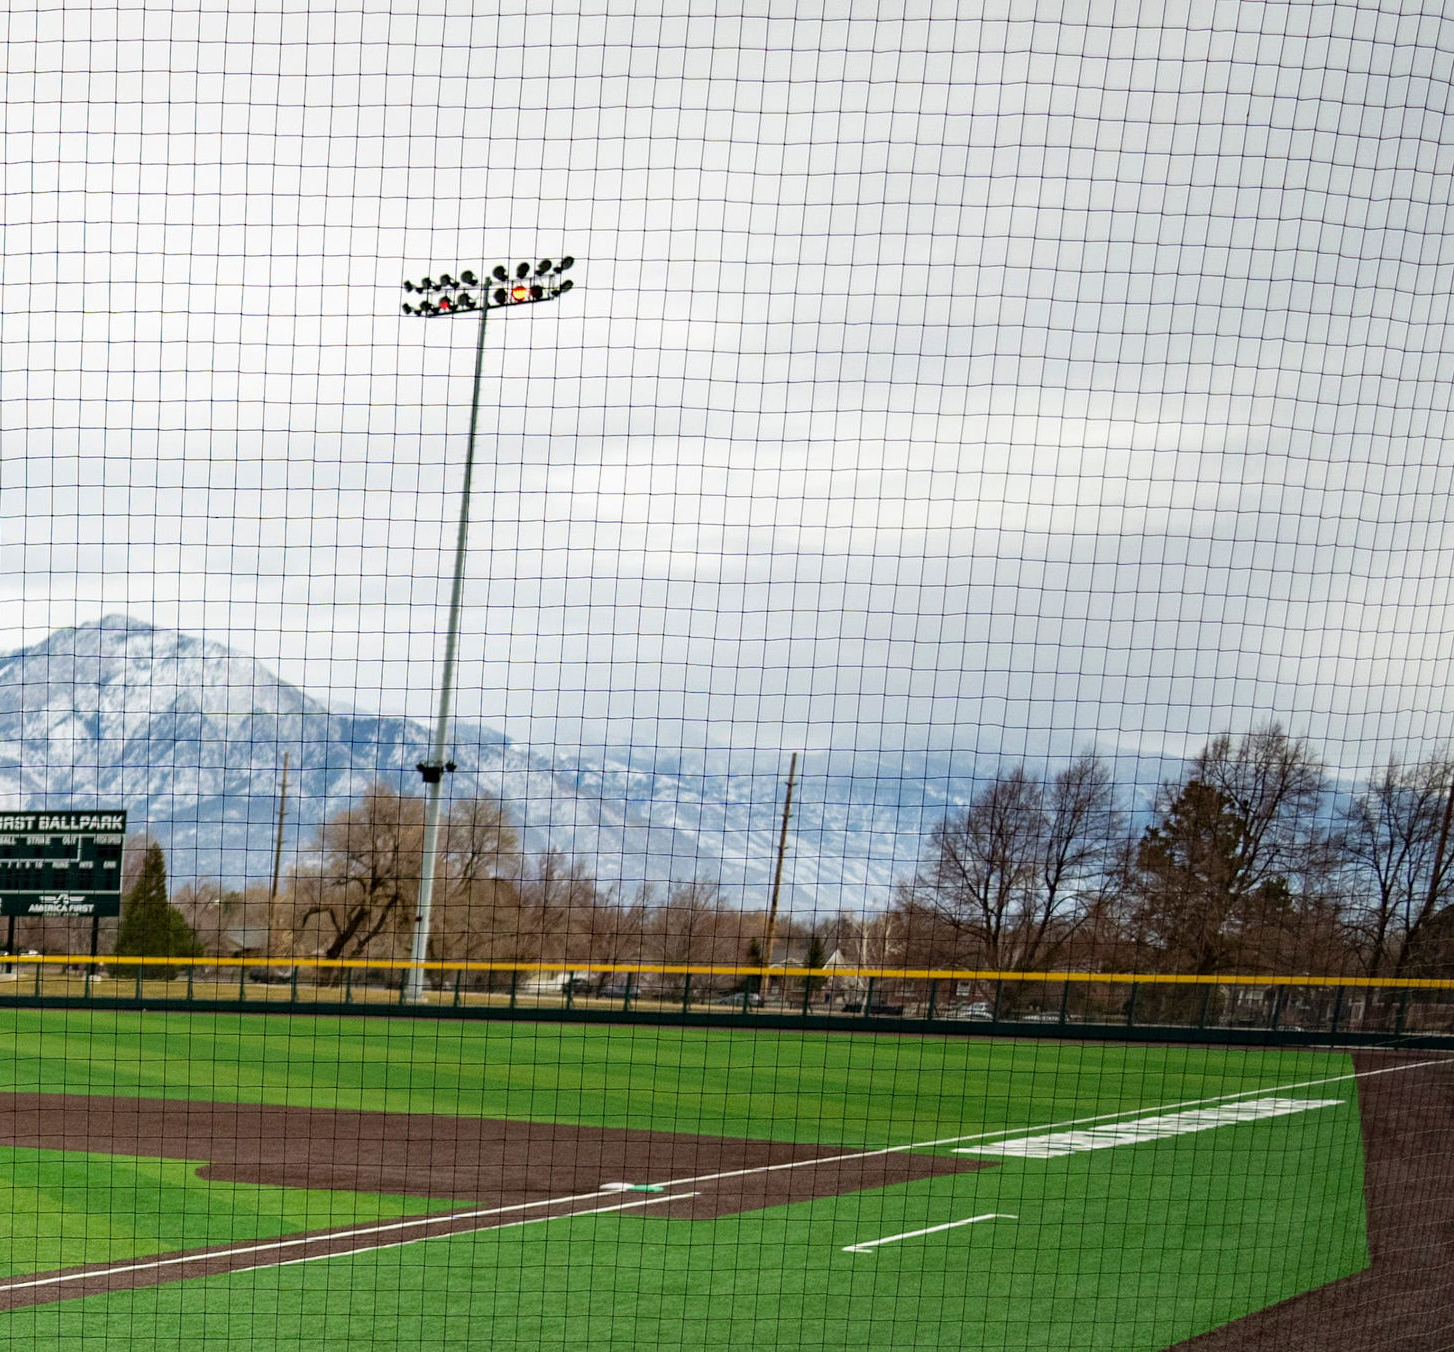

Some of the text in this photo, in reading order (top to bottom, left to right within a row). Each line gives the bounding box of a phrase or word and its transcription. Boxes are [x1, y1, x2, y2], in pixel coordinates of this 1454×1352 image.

[38, 815, 123, 830] BALLPARK
[28, 904, 94, 913] AMERICA FIRST
